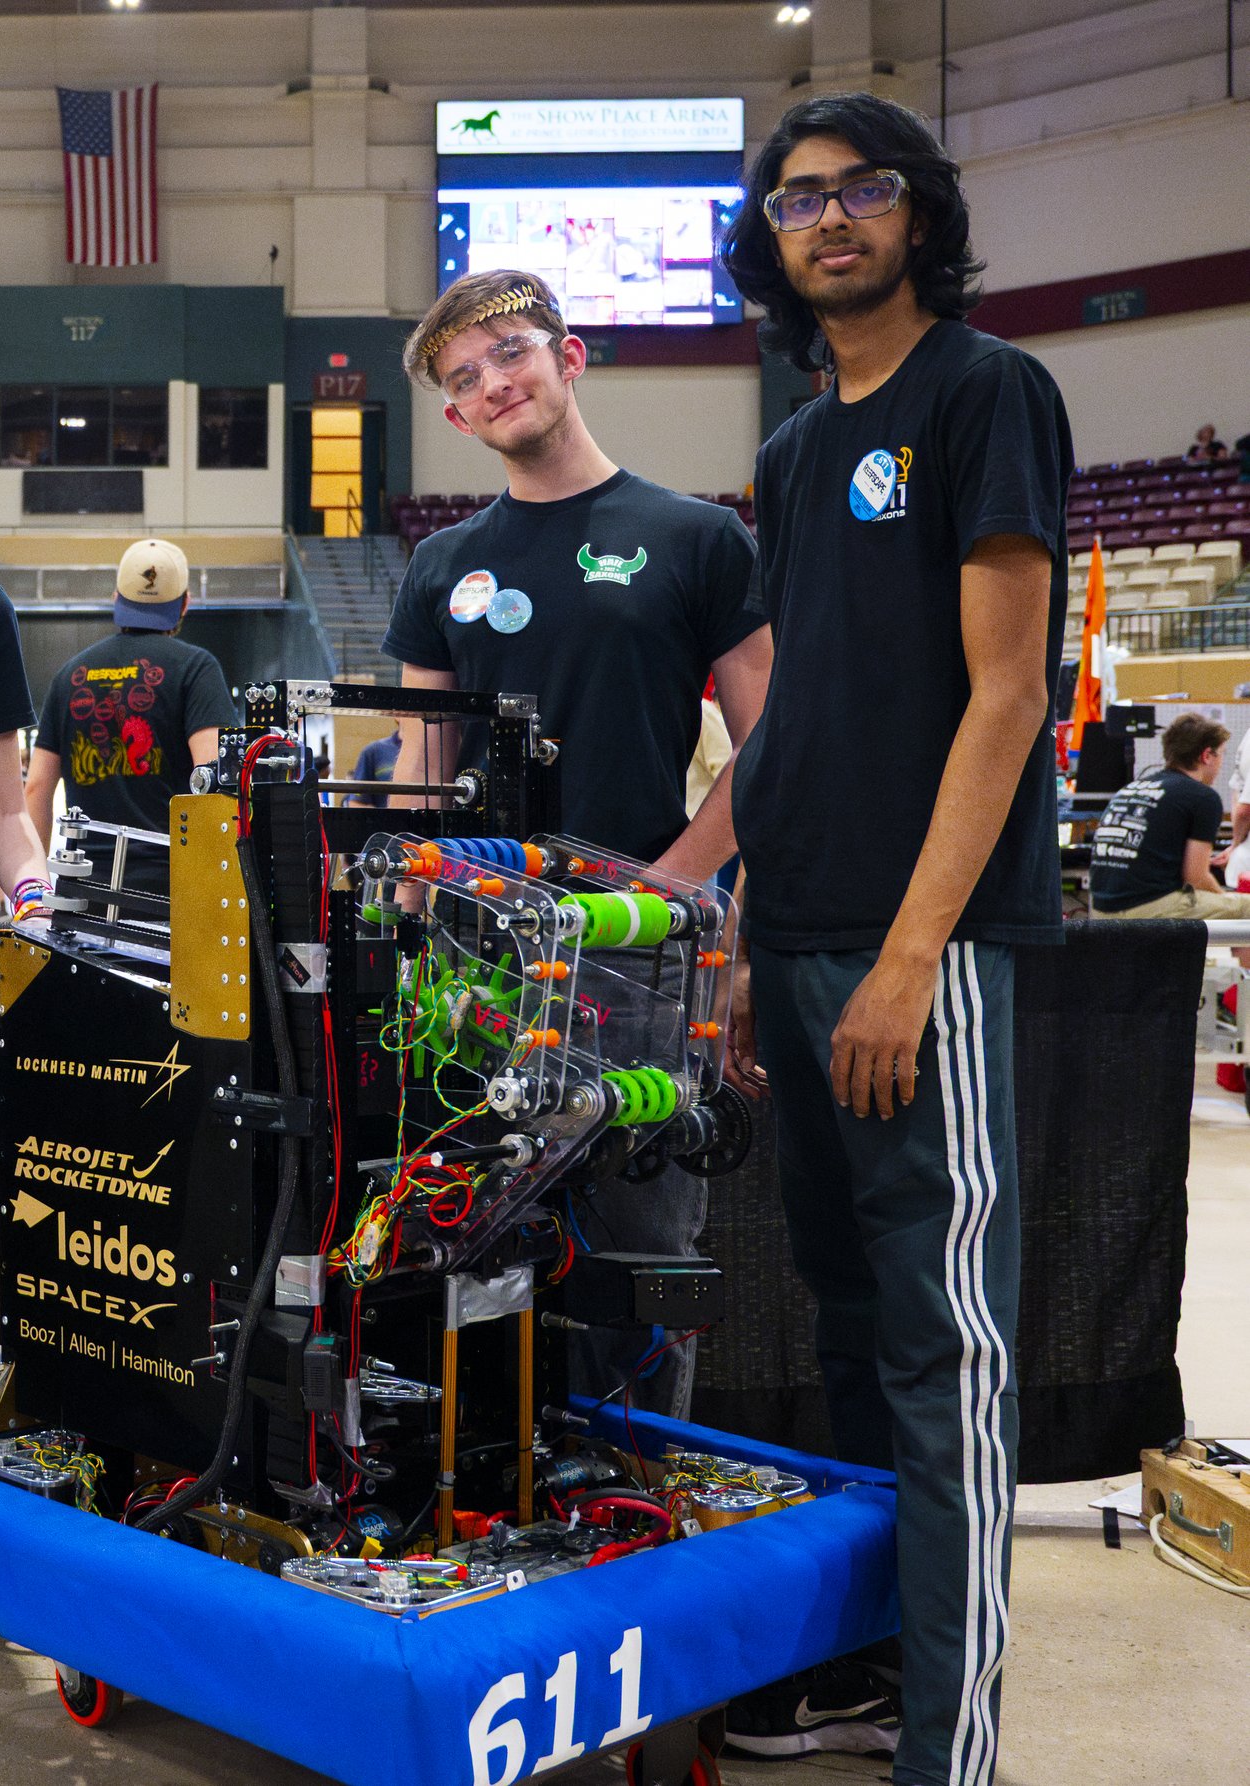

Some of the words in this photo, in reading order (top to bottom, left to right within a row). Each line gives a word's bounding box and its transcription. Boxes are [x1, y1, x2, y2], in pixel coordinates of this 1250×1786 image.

[537, 108, 596, 124] SHOW
[601, 108, 658, 123] PLACE
[664, 106, 729, 122] ARENA
[690, 126, 729, 136] CENTER
[70, 325, 97, 341] 117
[319, 374, 362, 397] P17
[862, 463, 887, 494] REEFSCAPE
[588, 570, 629, 583] SAXONS
[597, 558, 624, 569] HAIL
[16, 1056, 86, 1077] LOCKHEED
[91, 1065, 147, 1085] MARTIN
[14, 1135, 135, 1171] AEROJET
[14, 1158, 172, 1206] ROCKETDYNE
[58, 1211, 177, 1287] leidos
[16, 1272, 178, 1330] SPACEX
[19, 1318, 56, 1346] Booz
[69, 1332, 106, 1362] Allen
[122, 1347, 196, 1387] Hamilton
[359, 1522, 388, 1536] KRAKEN
[468, 1626, 653, 1786] 611
